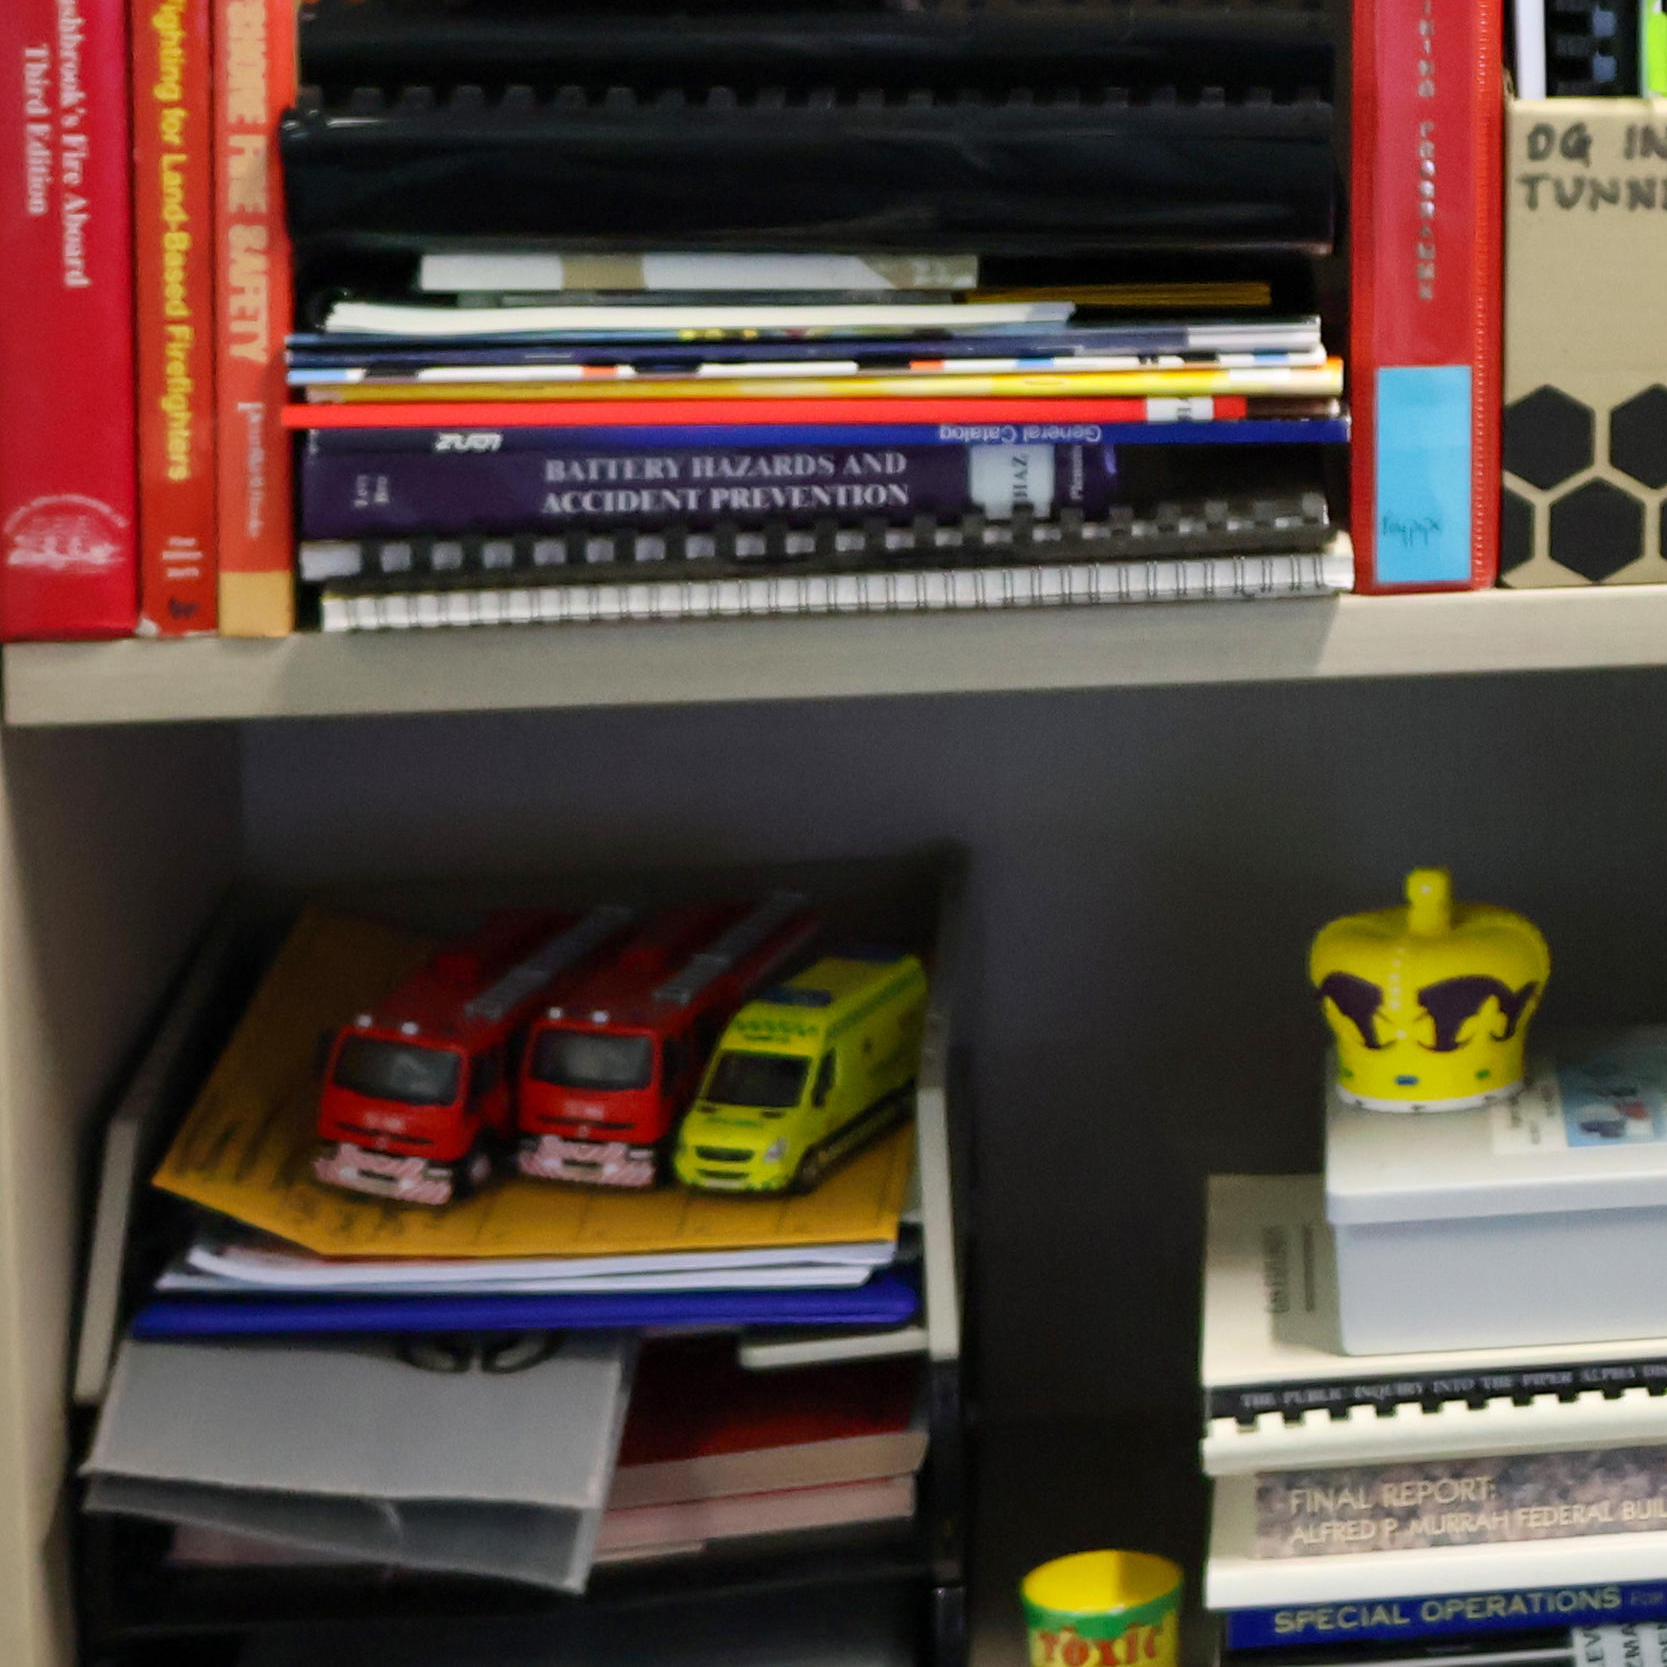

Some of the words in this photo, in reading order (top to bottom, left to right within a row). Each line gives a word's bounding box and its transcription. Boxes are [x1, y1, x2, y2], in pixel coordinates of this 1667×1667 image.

[23, 44, 51, 115] Third
[161, 108, 188, 146] for
[24, 122, 53, 214] Edition
[60, 135, 87, 185] Fire
[62, 192, 91, 286] Aboard
[158, 153, 190, 317] Land-Based
[160, 325, 194, 480] Firefighters
[544, 455, 679, 483] BATTERY
[691, 453, 840, 481] HAZARDS
[851, 451, 907, 477] AND
[543, 488, 702, 515] ACCIDENT
[711, 483, 910, 512] PREVENTION
[1290, 1485, 1373, 1516] FINAL
[1382, 1477, 1496, 1511] REPORT:
[1289, 1517, 1374, 1546] ALFRED
[1409, 1510, 1509, 1537] MURRAH
[1513, 1503, 1614, 1530] FEDERAL
[1274, 1597, 1409, 1635] SPECIAL
[1421, 1586, 1621, 1625] OPERATIONS
